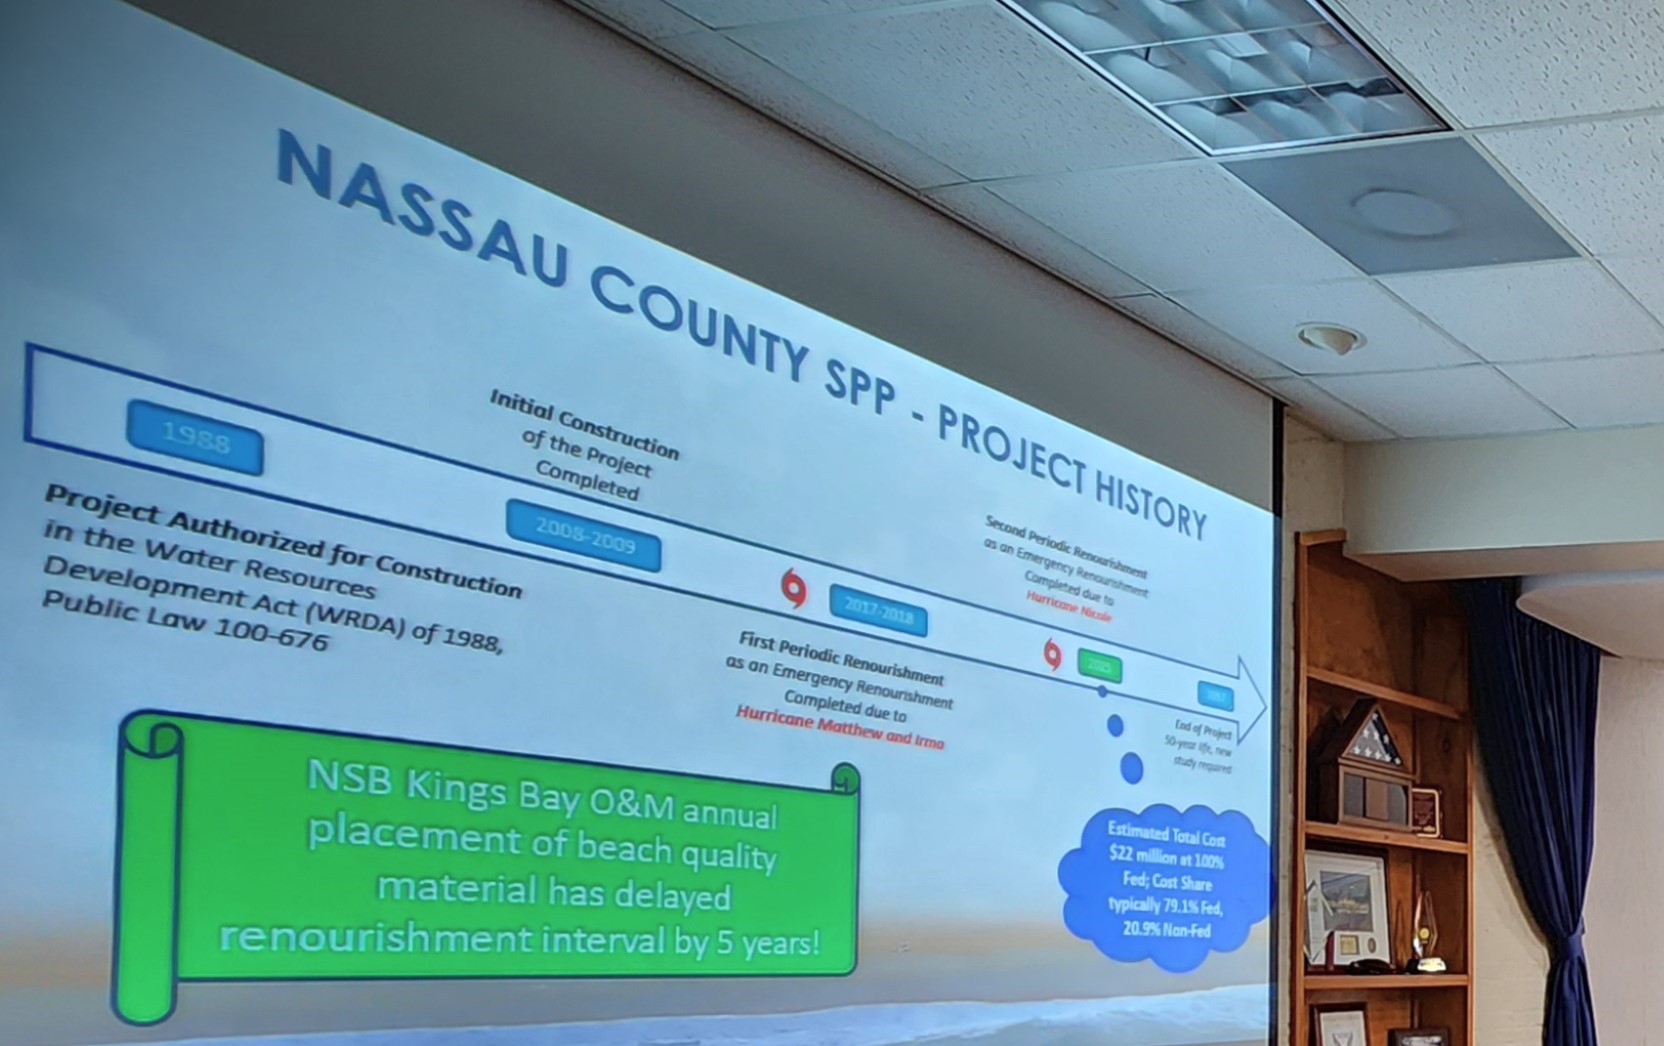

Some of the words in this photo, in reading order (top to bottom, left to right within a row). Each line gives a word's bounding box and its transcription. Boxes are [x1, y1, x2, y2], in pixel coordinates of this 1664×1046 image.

[277, 128, 567, 288] NASSAU
[590, 265, 810, 383] COUNTY
[825, 359, 896, 415] SPP
[938, 404, 1087, 495] PROJECT
[1096, 470, 1208, 541] HISTORY
[162, 421, 231, 455] 1988
[489, 387, 554, 421] Initial
[558, 410, 680, 462] Construction
[522, 426, 545, 448] of
[549, 434, 582, 459] the
[586, 445, 653, 481] Project
[535, 460, 640, 503] Completed
[45, 483, 160, 526] Project
[172, 510, 324, 559] Authorized
[331, 543, 369, 568] for
[375, 554, 523, 599] Construction
[535, 516, 637, 556] 2008-2009
[985, 514, 1026, 539] Second
[1028, 530, 1071, 554] Periodic
[1073, 546, 1148, 580] Renourishment
[43, 519, 73, 543] in
[80, 524, 135, 554] the
[144, 538, 236, 576] Water
[243, 558, 378, 600] Resources
[984, 538, 997, 550] as
[1000, 543, 1014, 555] an
[1016, 547, 1074, 576] Emergency
[1076, 566, 1149, 599] Renourishment
[43, 555, 245, 610] Development
[252, 592, 299, 618] Act
[305, 602, 407, 641] (WRDA)
[411, 623, 440, 646] of
[443, 628, 504, 656] 1988,
[845, 596, 915, 625] 2017-2018
[1025, 570, 1081, 597] Completed
[1082, 588, 1100, 601] due
[1104, 594, 1114, 606] to
[1027, 590, 1079, 613] Hurricane
[42, 589, 138, 625] Public
[147, 606, 206, 633] Law
[214, 618, 329, 653] 100-676
[739, 630, 776, 652] First
[779, 640, 840, 665] Periodic
[843, 654, 945, 687] Renourishment
[725, 656, 744, 670] as
[748, 661, 769, 674] an
[772, 663, 853, 693] Emergency
[856, 680, 954, 711] Renourishment
[784, 689, 862, 715] Completed
[865, 704, 891, 720] due
[893, 709, 907, 723] to
[735, 704, 814, 729] Hurricane
[817, 717, 884, 740] Matthew
[886, 730, 912, 745] and
[915, 734, 945, 750] Irma
[1175, 719, 1191, 732] End
[1193, 723, 1202, 734] of
[1204, 726, 1232, 741] Project
[308, 758, 392, 796] NSB
[407, 769, 507, 812] Kings
[520, 781, 580, 819] Bay
[591, 788, 674, 822] O&M
[682, 800, 779, 832] annual
[308, 811, 522, 857] placement
[532, 827, 571, 857] of
[578, 834, 672, 866] beach
[682, 841, 778, 877] quality
[1108, 820, 1169, 841] Estimated
[1173, 827, 1200, 843] Total
[1202, 832, 1226, 848] Cost
[1109, 846, 1133, 863] $22
[1136, 848, 1177, 865] million
[1180, 854, 1192, 866] at
[1194, 854, 1225, 870] 100%
[377, 872, 537, 905] material
[548, 878, 605, 908] has
[615, 879, 732, 917] delayed
[1123, 871, 1150, 889] Fed;
[1152, 873, 1178, 889] Cost
[1181, 875, 1213, 891] Share
[1108, 897, 1161, 915] typically
[1164, 899, 1198, 914] 79.1%
[1201, 901, 1224, 917] Fed,
[1123, 921, 1161, 936] 20.9%
[1163, 922, 1211, 938] Non-Fed
[219, 919, 535, 956] renourishment
[542, 925, 666, 955] interval
[673, 927, 710, 963] by
[717, 928, 734, 955] 5
[742, 929, 822, 960] years!
